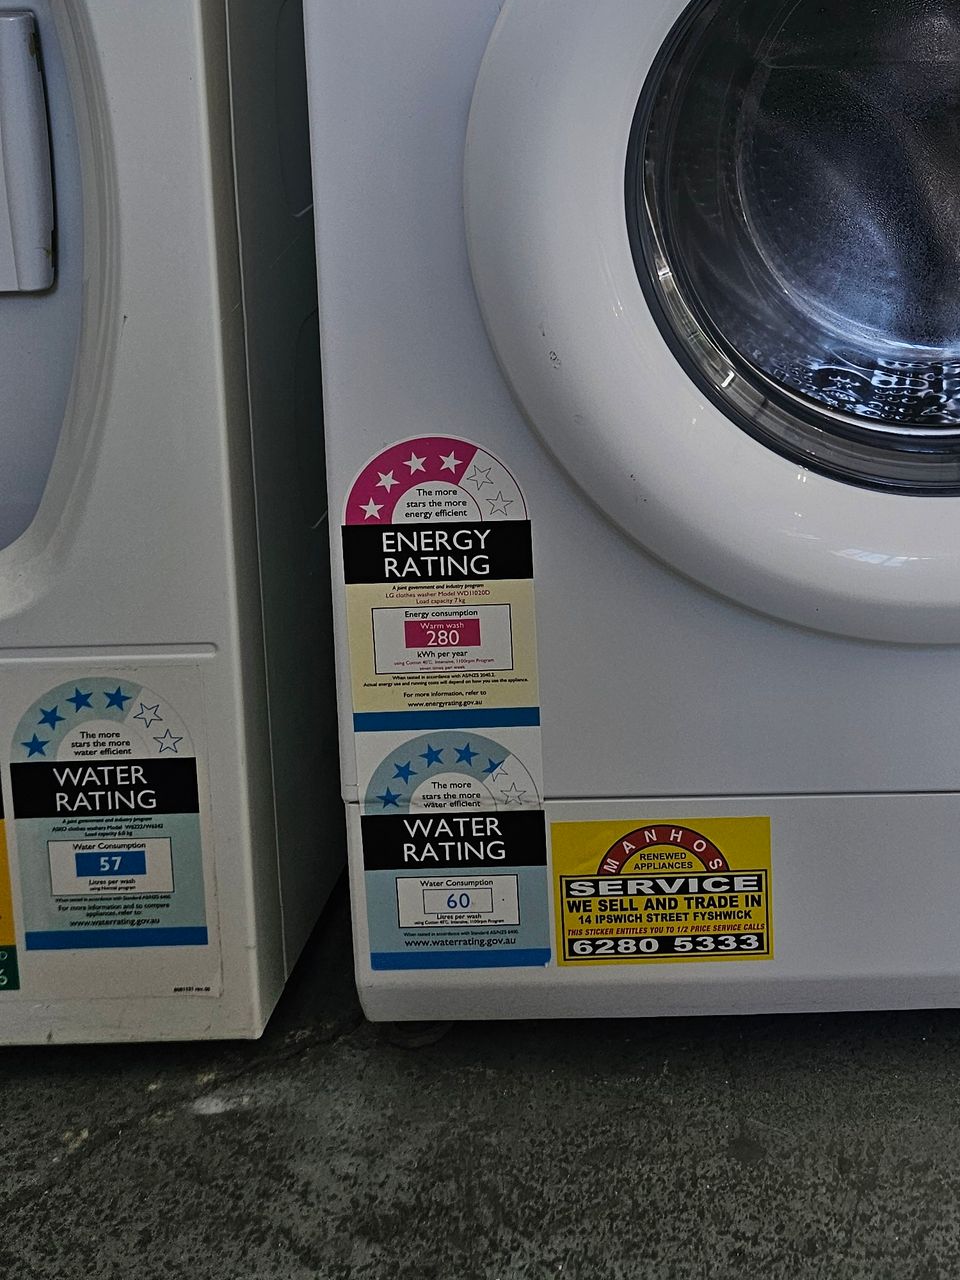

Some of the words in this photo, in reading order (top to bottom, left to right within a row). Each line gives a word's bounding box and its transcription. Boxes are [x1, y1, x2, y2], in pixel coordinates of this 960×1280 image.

[382, 529, 491, 552] ENERGY
[385, 555, 490, 577] RATING
[426, 630, 459, 646] 280
[53, 766, 147, 786] WATER
[56, 790, 156, 812] RATING
[404, 818, 502, 838] WATER
[98, 842, 146, 850] Consumption
[404, 841, 505, 862] RATING
[604, 829, 722, 873] MANHOS
[100, 857, 122, 871] 57
[634, 862, 693, 870] APPLIANCES
[570, 876, 758, 896] SERVICE
[447, 893, 470, 908] 60
[567, 900, 592, 912] WE
[598, 898, 638, 911] SELL
[644, 897, 678, 910] AND
[684, 895, 738, 909] TRADE
[745, 895, 761, 907] IN
[578, 916, 591, 924] 14
[595, 914, 643, 924] IPSWICH
[646, 913, 689, 923] STREET
[694, 910, 752, 921] FYSHWICK
[677, 925, 688, 933] 1/2
[405, 938, 516, 947] www.waterrating.gov.au
[573, 938, 659, 955] 6280
[674, 935, 759, 952] 5333
